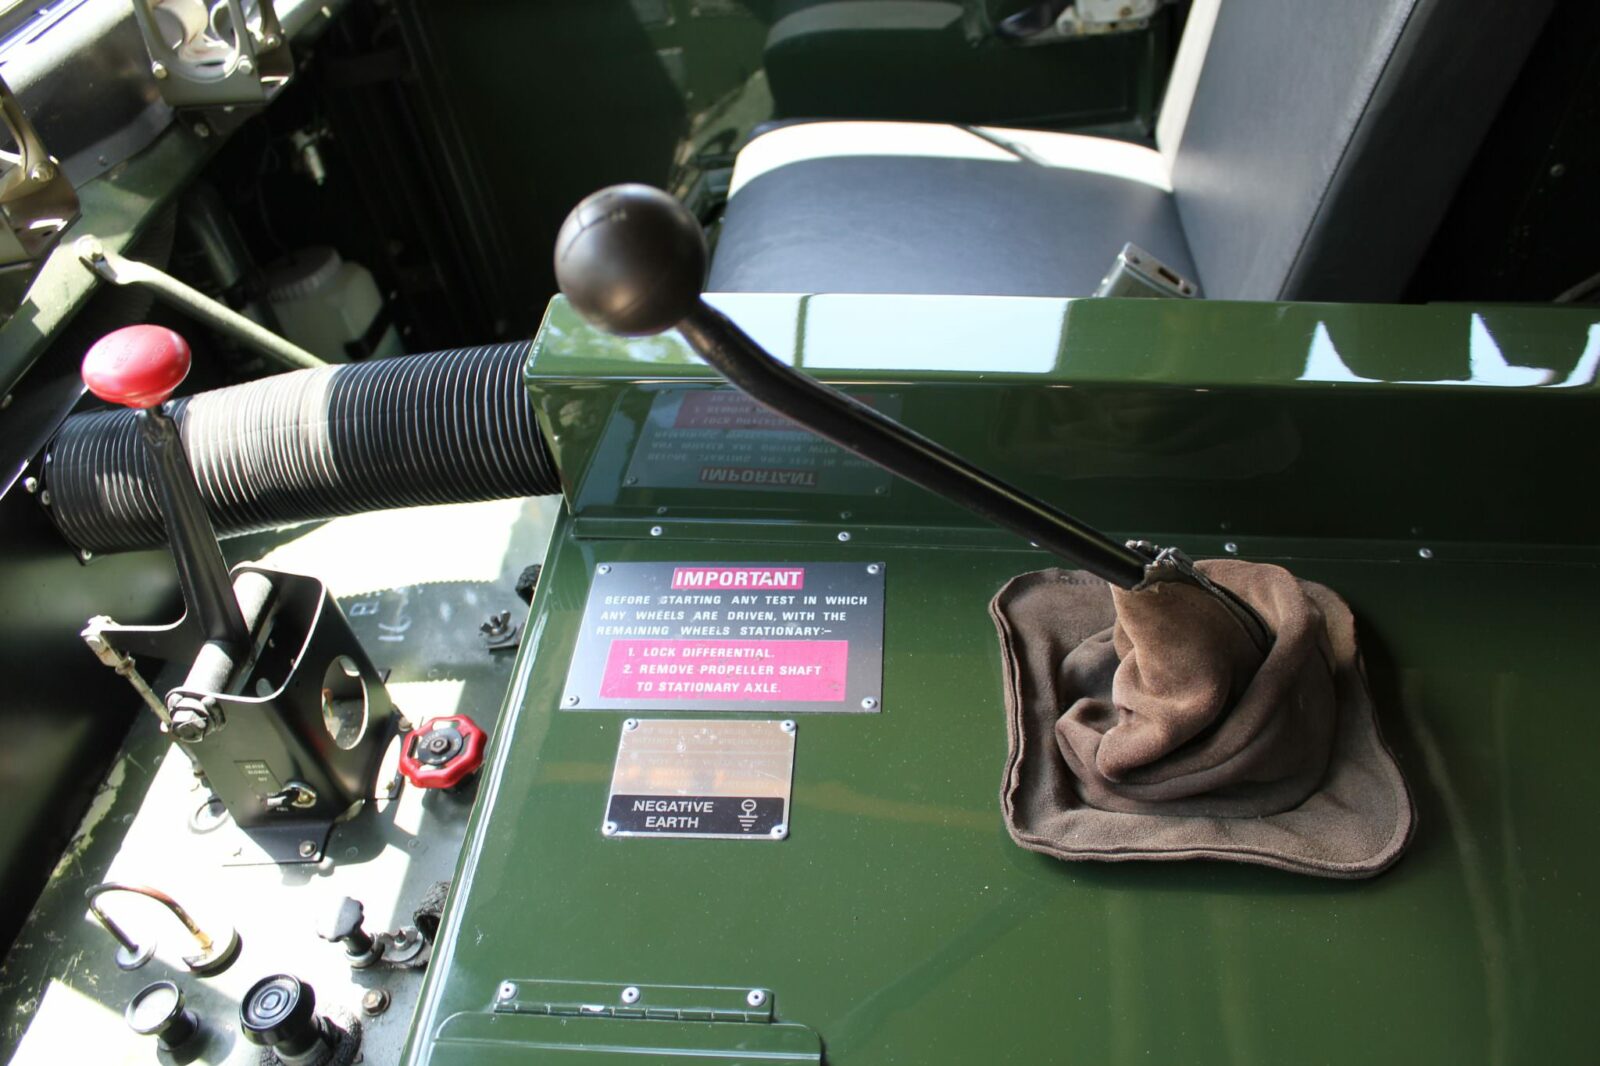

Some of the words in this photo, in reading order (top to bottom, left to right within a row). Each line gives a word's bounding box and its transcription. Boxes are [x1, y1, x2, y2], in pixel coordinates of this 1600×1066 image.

[675, 570, 802, 587] IMPORTANT
[604, 595, 651, 605] BEFORE
[659, 595, 722, 605] STARTING
[731, 595, 758, 605] ANY
[765, 595, 796, 605] TEST
[803, 596, 818, 605] IN
[825, 596, 868, 606] WHICH
[600, 611, 626, 621] ANY
[635, 611, 685, 621] WHEELS
[692, 611, 719, 621] ARE
[727, 611, 777, 622] DRIVEN,
[782, 611, 816, 621] WITH
[823, 612, 847, 621] THE
[596, 625, 670, 636] REMAINING
[680, 625, 731, 636] WHEELS
[628, 647, 636, 657] 1.
[643, 647, 677, 657] LOCK
[682, 647, 775, 658] DIFFERENTIAL.
[639, 664, 694, 675] REMOVE
[699, 664, 774, 675] PROPELLER
[779, 665, 823, 676] SHAFT
[637, 681, 653, 692] TO
[658, 681, 739, 693] STATIONARY
[744, 682, 782, 693] AXLE.
[633, 800, 715, 813] NEGATIVE
[645, 816, 700, 829] EARTH
